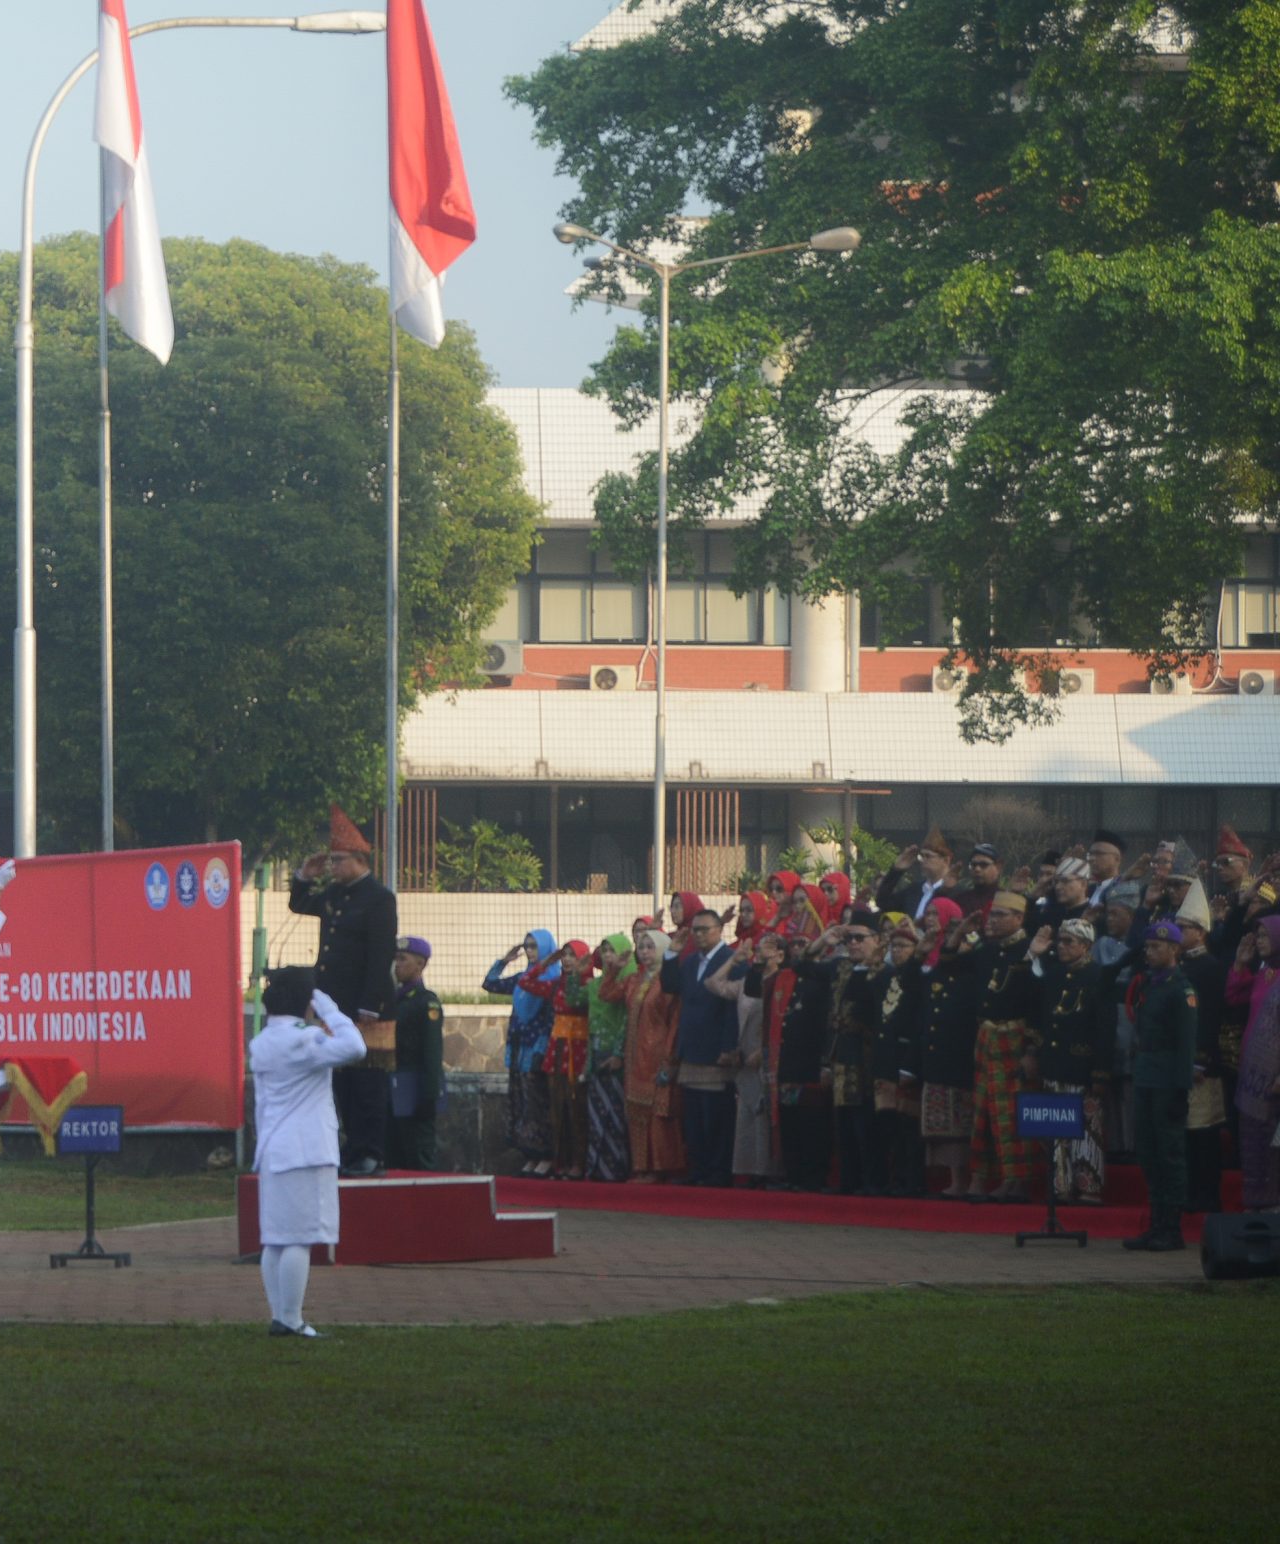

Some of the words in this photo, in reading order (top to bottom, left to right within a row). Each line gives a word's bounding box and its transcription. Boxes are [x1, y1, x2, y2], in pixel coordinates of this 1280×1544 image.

[47, 969, 192, 1001] KEMERDEKAAN
[42, 1011, 147, 1042] INDONESIA
[1022, 1107, 1076, 1122] PIMPINAN
[62, 1121, 119, 1137] REKTOR
